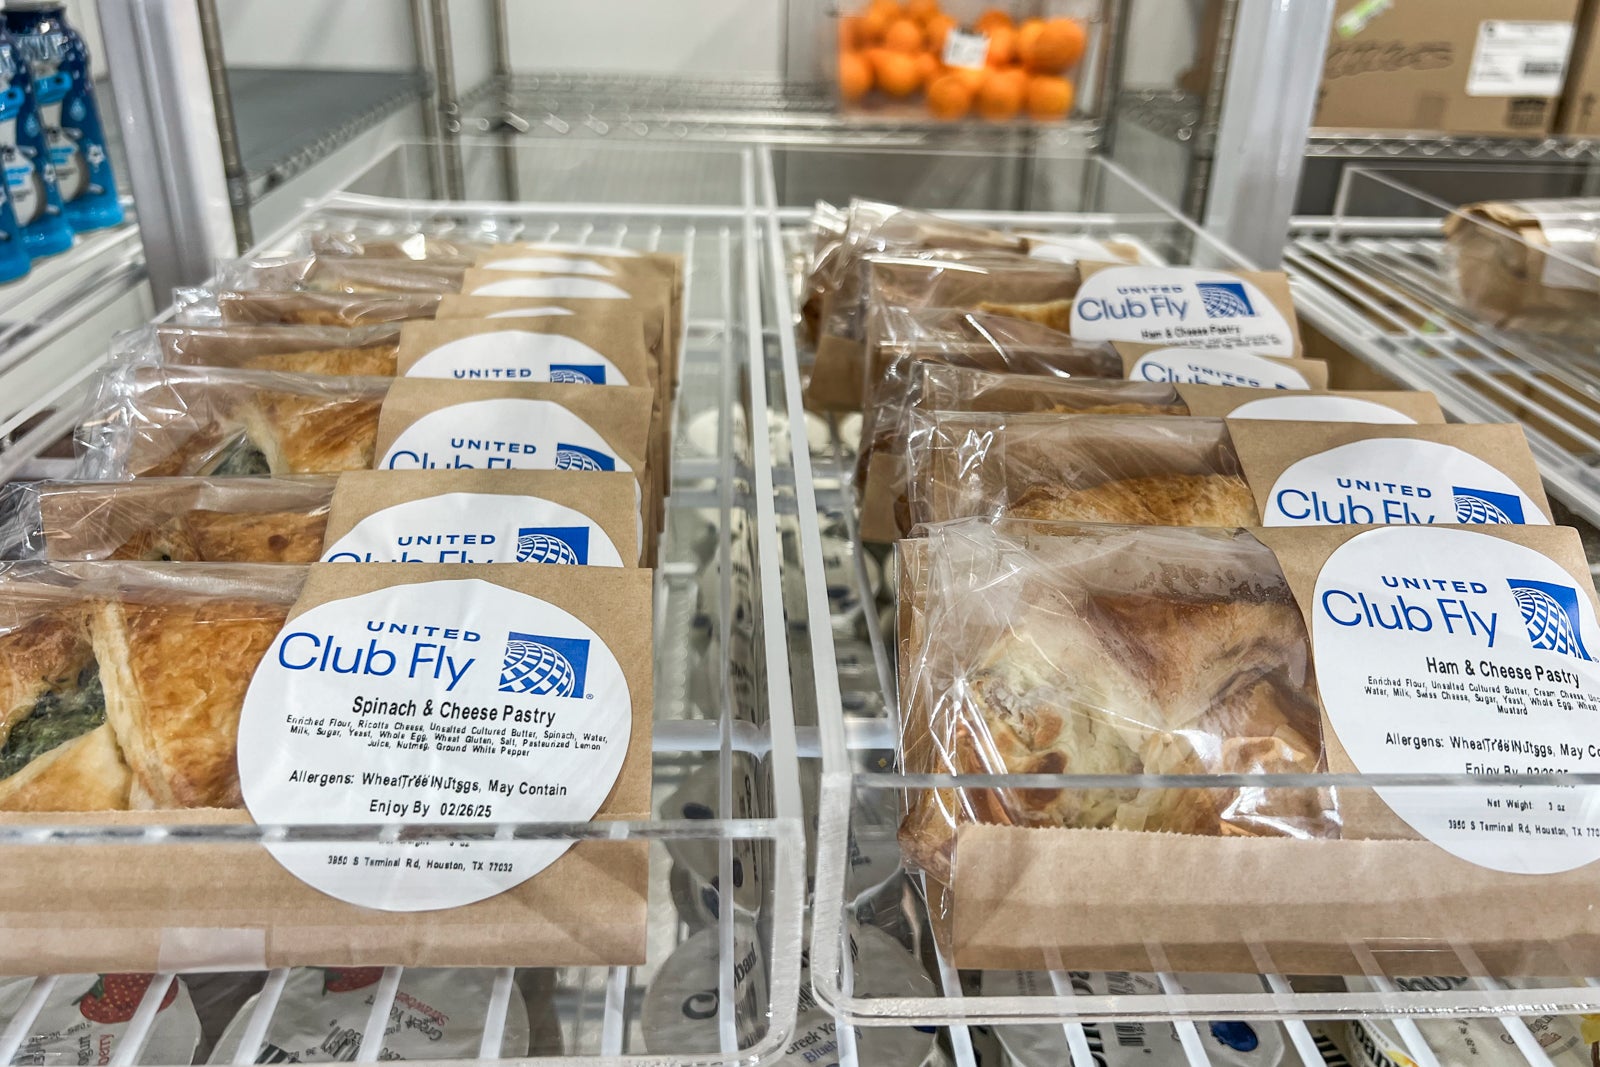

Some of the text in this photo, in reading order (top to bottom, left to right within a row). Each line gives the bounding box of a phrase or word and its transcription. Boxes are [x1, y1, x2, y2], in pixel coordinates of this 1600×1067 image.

[1117, 285, 1183, 295] UNITED
[1077, 295, 1189, 321] Club Fly
[454, 368, 532, 379] UNITED
[1187, 364, 1261, 387] UNITED
[451, 438, 537, 455] UNITED
[1336, 478, 1432, 498] UNITED
[1276, 489, 1374, 525] Club
[397, 534, 496, 546] UNITED
[1381, 576, 1488, 594] UNITED
[1322, 589, 1498, 648] Club Fly
[366, 620, 482, 642] UNITED
[278, 632, 476, 692] Club Fly
[1425, 656, 1580, 690] Ham & Cheese Pastry
[1363, 686, 1388, 698] Water,
[1474, 694, 1499, 705] Sugar,
[1529, 698, 1553, 707] Whole
[1367, 676, 1400, 686] Enriched
[1431, 681, 1464, 691] Unsalted
[1468, 684, 1500, 693] Cultured
[1504, 686, 1530, 697] Butter,
[1533, 688, 1555, 697] Cream
[352, 696, 556, 728] Spinach & Cheese Pastry
[1497, 705, 1527, 715] Mustard
[286, 715, 325, 727] Enriched
[328, 719, 353, 728] Flour,
[358, 720, 389, 730] Ricotta
[430, 723, 467, 735] Unsalted
[471, 726, 507, 737] Cultured
[511, 728, 539, 740] Butter,
[543, 730, 577, 742] Spinach,
[583, 732, 608, 744] Water,
[290, 725, 311, 735] Milk,
[316, 727, 342, 738] Sugar,
[349, 728, 373, 739] Yeast,
[379, 731, 405, 740] Whole
[434, 733, 460, 743] Wheat
[465, 735, 495, 746] Gluten,
[500, 737, 518, 747] Salt,
[522, 738, 571, 750] Pasteurized
[574, 741, 601, 751] Lemon
[436, 743, 467, 753] Ground
[472, 745, 496, 755] White
[500, 746, 530, 757] Pepper
[1385, 733, 1444, 749] Allergens:
[1560, 743, 1584, 760] May
[288, 770, 355, 787] Allergens:
[488, 779, 515, 797] May
[519, 782, 568, 796] Contain
[369, 799, 493, 818] Enjoy By 02/26/25
[1487, 798, 1501, 808] Net
[1470, 821, 1476, 831] S
[1480, 821, 1514, 833] Terminal
[1571, 826, 1582, 837] TX
[352, 856, 360, 867] S
[364, 857, 401, 868] Terminal
[405, 858, 422, 870] Rd,
[426, 860, 467, 872] Houston,
[472, 861, 484, 870] TX
[488, 862, 514, 873] 77032
